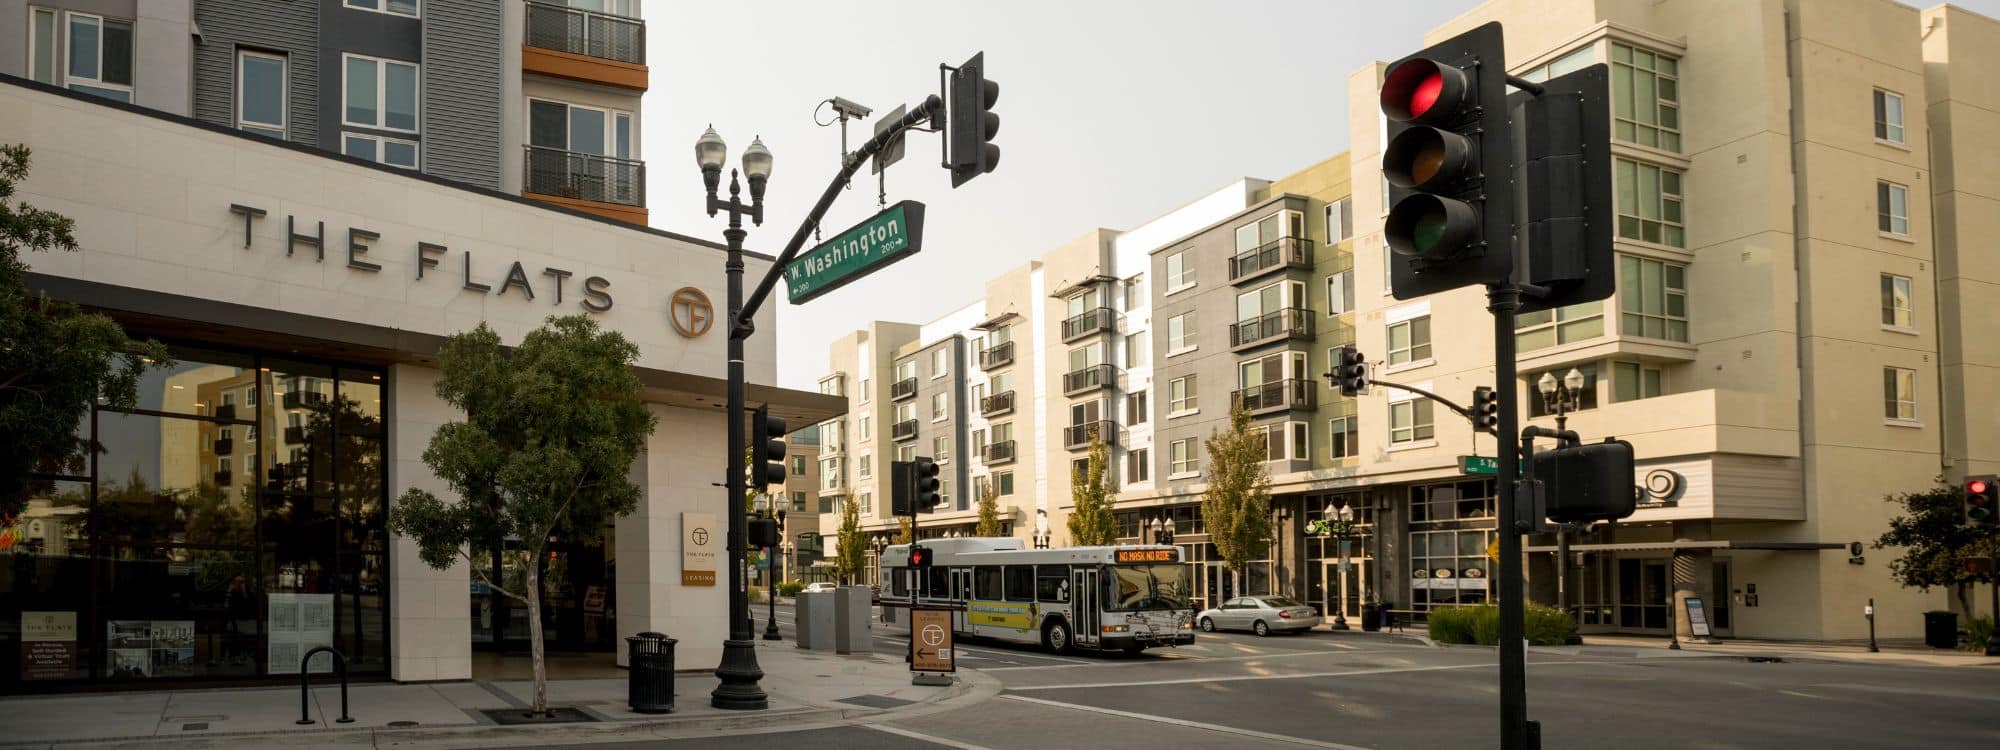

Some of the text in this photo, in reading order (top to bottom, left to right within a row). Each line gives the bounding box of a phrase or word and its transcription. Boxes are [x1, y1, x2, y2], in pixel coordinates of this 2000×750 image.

[230, 203, 614, 314] THE FLATS
[791, 218, 898, 281] W. Washington
[881, 240, 895, 254] 200
[1119, 550, 1169, 561] NO MASK NO RIDE
